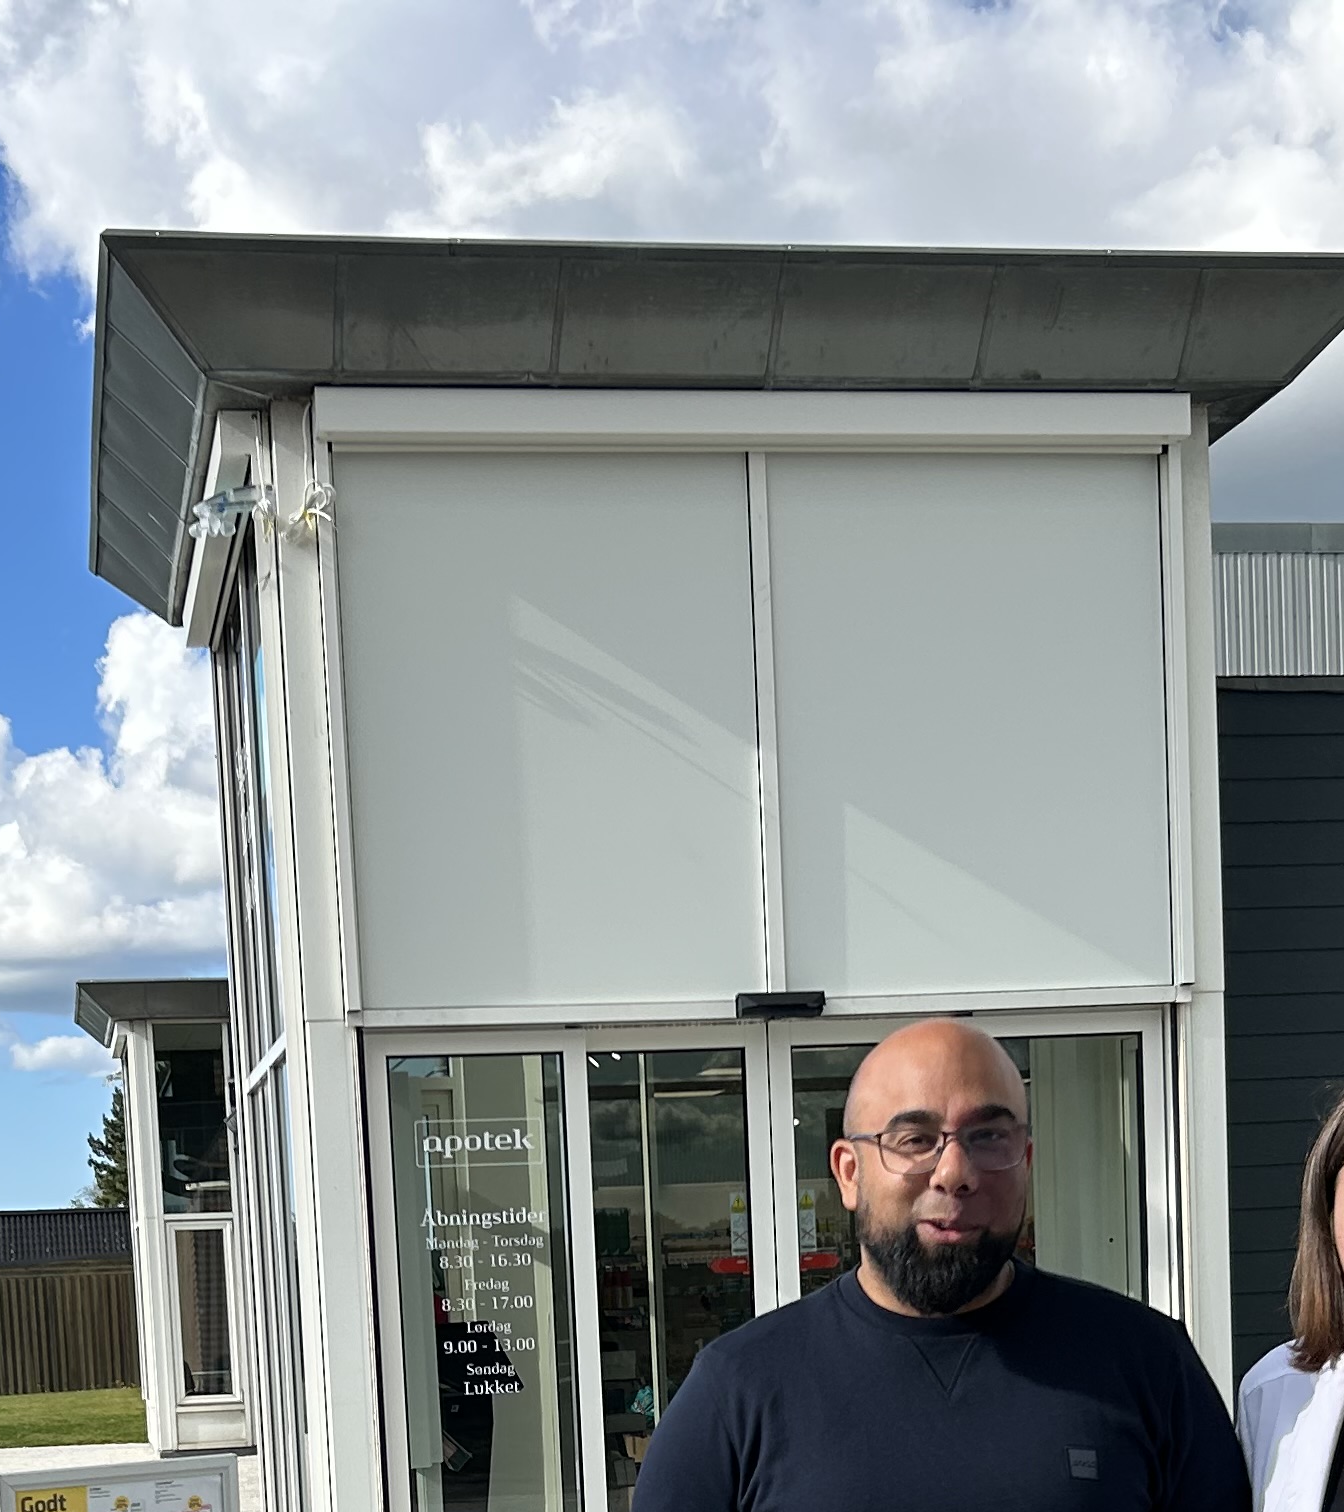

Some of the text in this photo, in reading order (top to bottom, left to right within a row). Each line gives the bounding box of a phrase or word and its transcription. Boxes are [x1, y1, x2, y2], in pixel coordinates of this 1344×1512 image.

[422, 1127, 536, 1159] apotek
[425, 1235, 480, 1251] Mandag
[491, 1233, 544, 1249] Torsdag
[439, 1255, 473, 1270] 8.30
[490, 1252, 532, 1268] 16.30
[465, 1277, 510, 1293] Fredag
[441, 1297, 475, 1312] 8.30
[491, 1294, 533, 1310] 17.00
[466, 1320, 513, 1335] Lørdag
[443, 1340, 477, 1355] 9.00
[494, 1337, 536, 1352] 13.00
[466, 1362, 516, 1377] Søndag
[463, 1379, 521, 1396] Lukket
